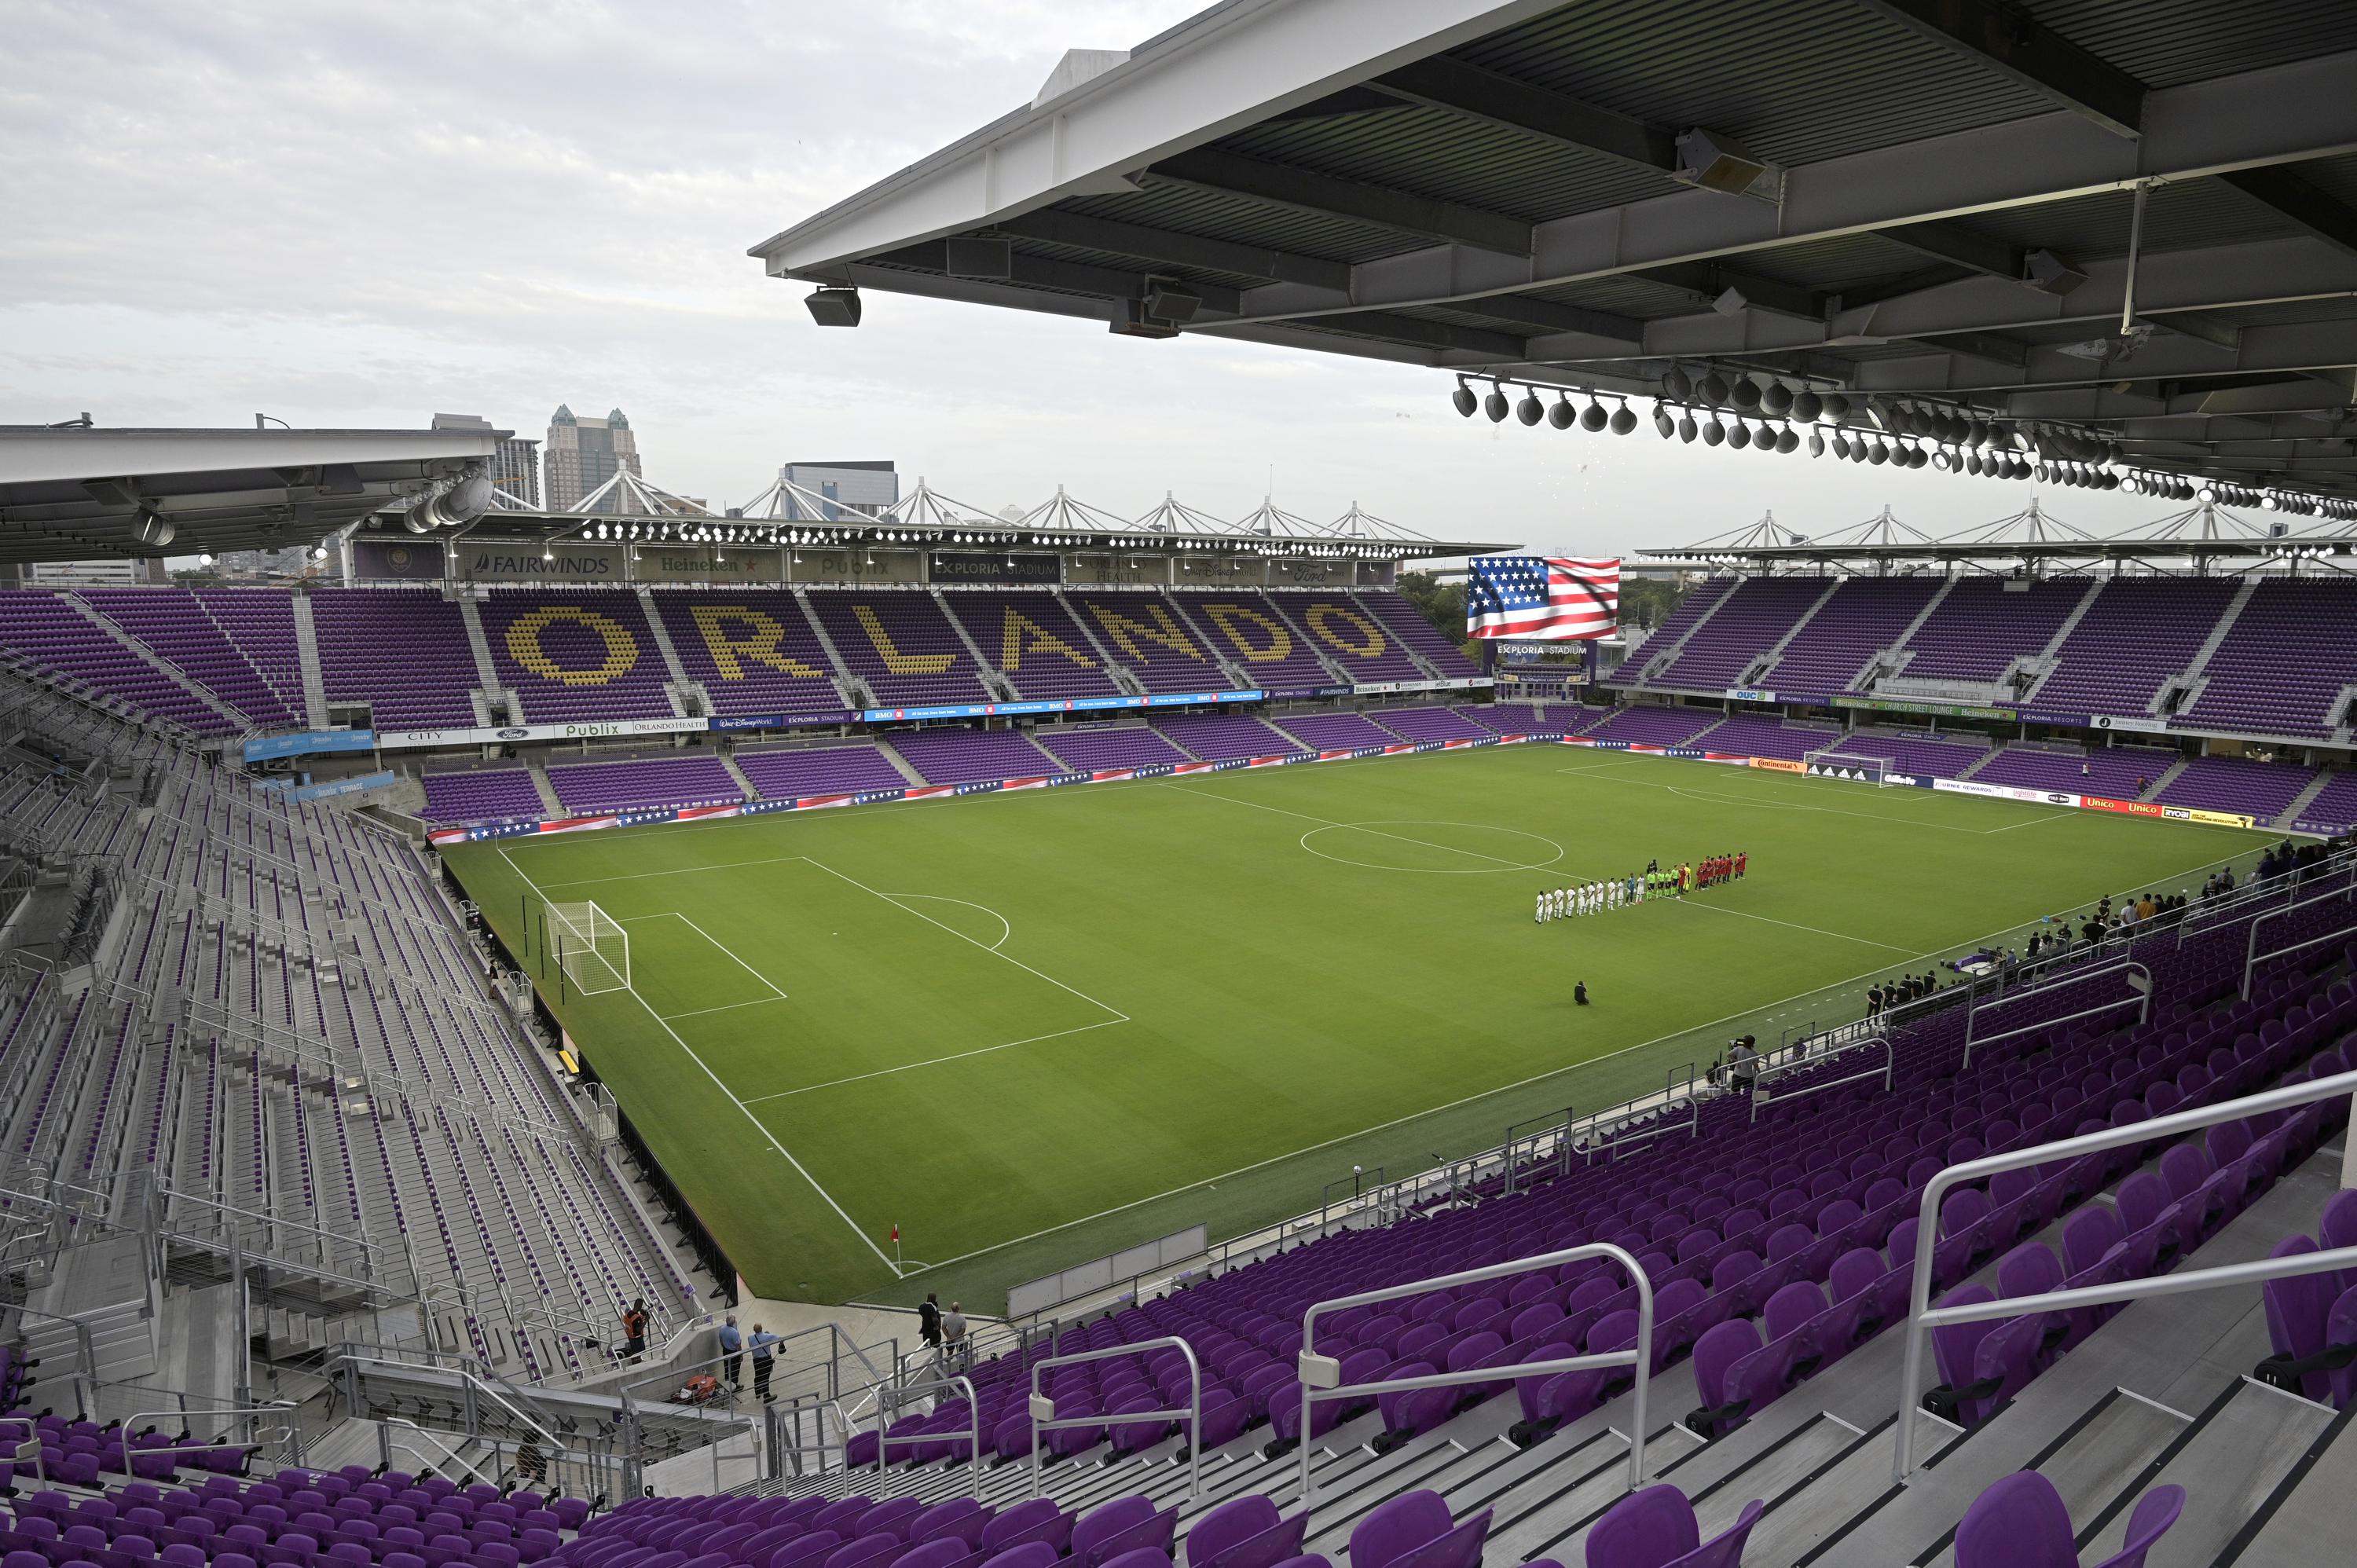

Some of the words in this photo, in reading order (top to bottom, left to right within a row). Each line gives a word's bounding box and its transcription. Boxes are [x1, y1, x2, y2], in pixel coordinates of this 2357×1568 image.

[493, 556, 609, 574] FAIRWINDS
[661, 557, 739, 572] Heineken
[822, 558, 889, 575] Publix
[935, 559, 1000, 574] EXPLORIA
[1007, 563, 1056, 575] STADIUM
[1097, 570, 1142, 582] HEALTH
[1294, 563, 1329, 582] Ford
[1497, 644, 1544, 654] EXPLORIA
[1549, 646, 1587, 654] STADIUM
[1736, 691, 1757, 700] OUC
[1835, 699, 1870, 709] Heineken
[1884, 702, 1908, 712] CHURCH
[1908, 704, 1928, 713] STREET
[1929, 705, 1953, 715] LOUNGE
[1960, 709, 2000, 719] Heineken
[566, 723, 618, 737] Publix
[634, 723, 675, 731] ORLANDO
[676, 721, 706, 730] HEALTH
[408, 731, 443, 741] CITY
[502, 729, 523, 738] Ford
[1758, 759, 1792, 769] Continental
[339, 783, 363, 793] TERRACE
[2087, 797, 2114, 808] Unico
[2128, 802, 2157, 814] Unico
[2165, 808, 2189, 819] RYOBI
[1691, 1421, 1696, 1431] S
[1512, 1432, 1518, 1441] R
